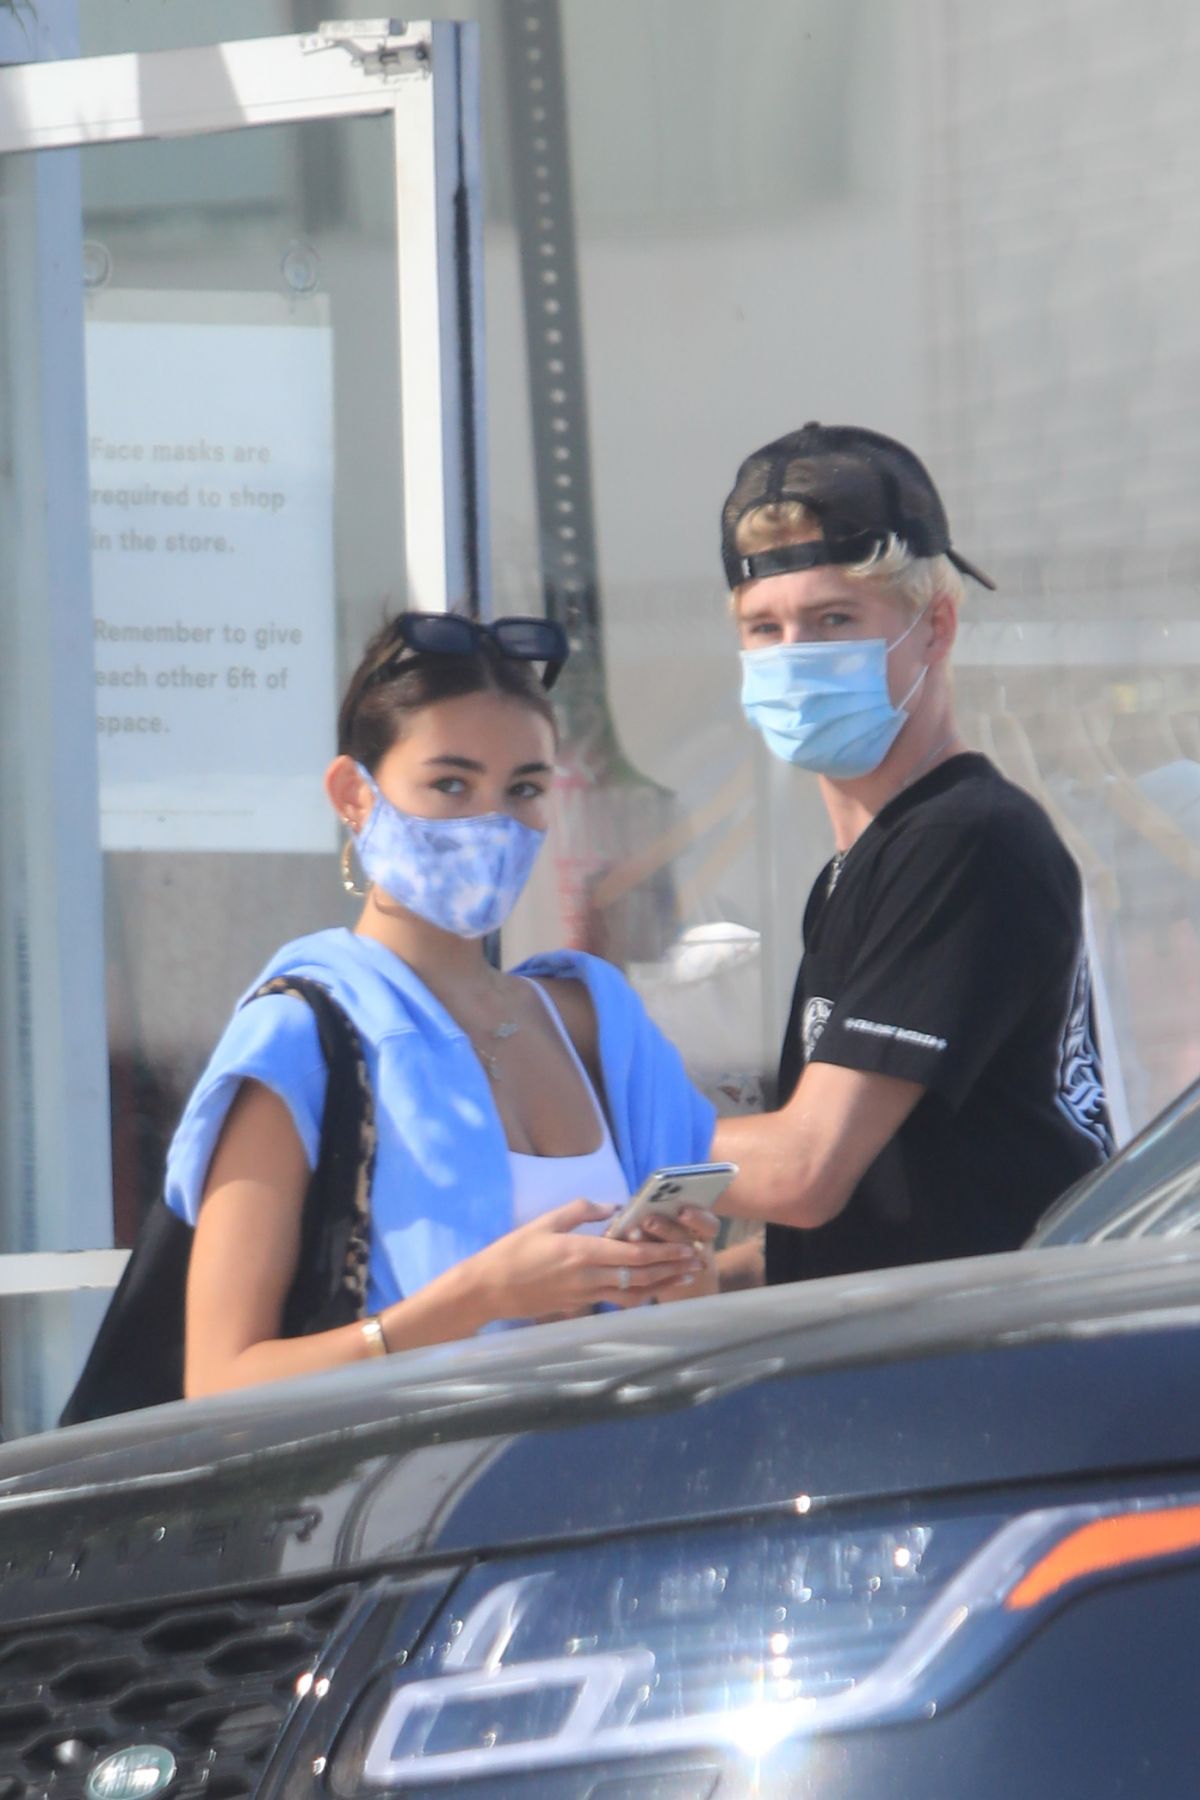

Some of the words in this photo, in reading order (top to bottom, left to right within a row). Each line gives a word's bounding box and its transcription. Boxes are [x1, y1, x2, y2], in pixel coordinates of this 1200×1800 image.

[91, 437, 144, 461] Face
[152, 438, 224, 462] masks
[233, 444, 271, 463] are
[91, 483, 189, 511] required
[197, 488, 221, 508] to
[229, 485, 286, 514] shop
[91, 529, 112, 551] in
[120, 527, 157, 551] the
[165, 532, 235, 553] store.
[94, 618, 215, 643] Remember
[223, 624, 247, 644] to
[255, 621, 303, 650] give
[95, 663, 148, 687] each
[155, 665, 218, 689] other
[226, 666, 257, 689] 6ft
[266, 667, 288, 689] of
[96, 714, 171, 736] space.
